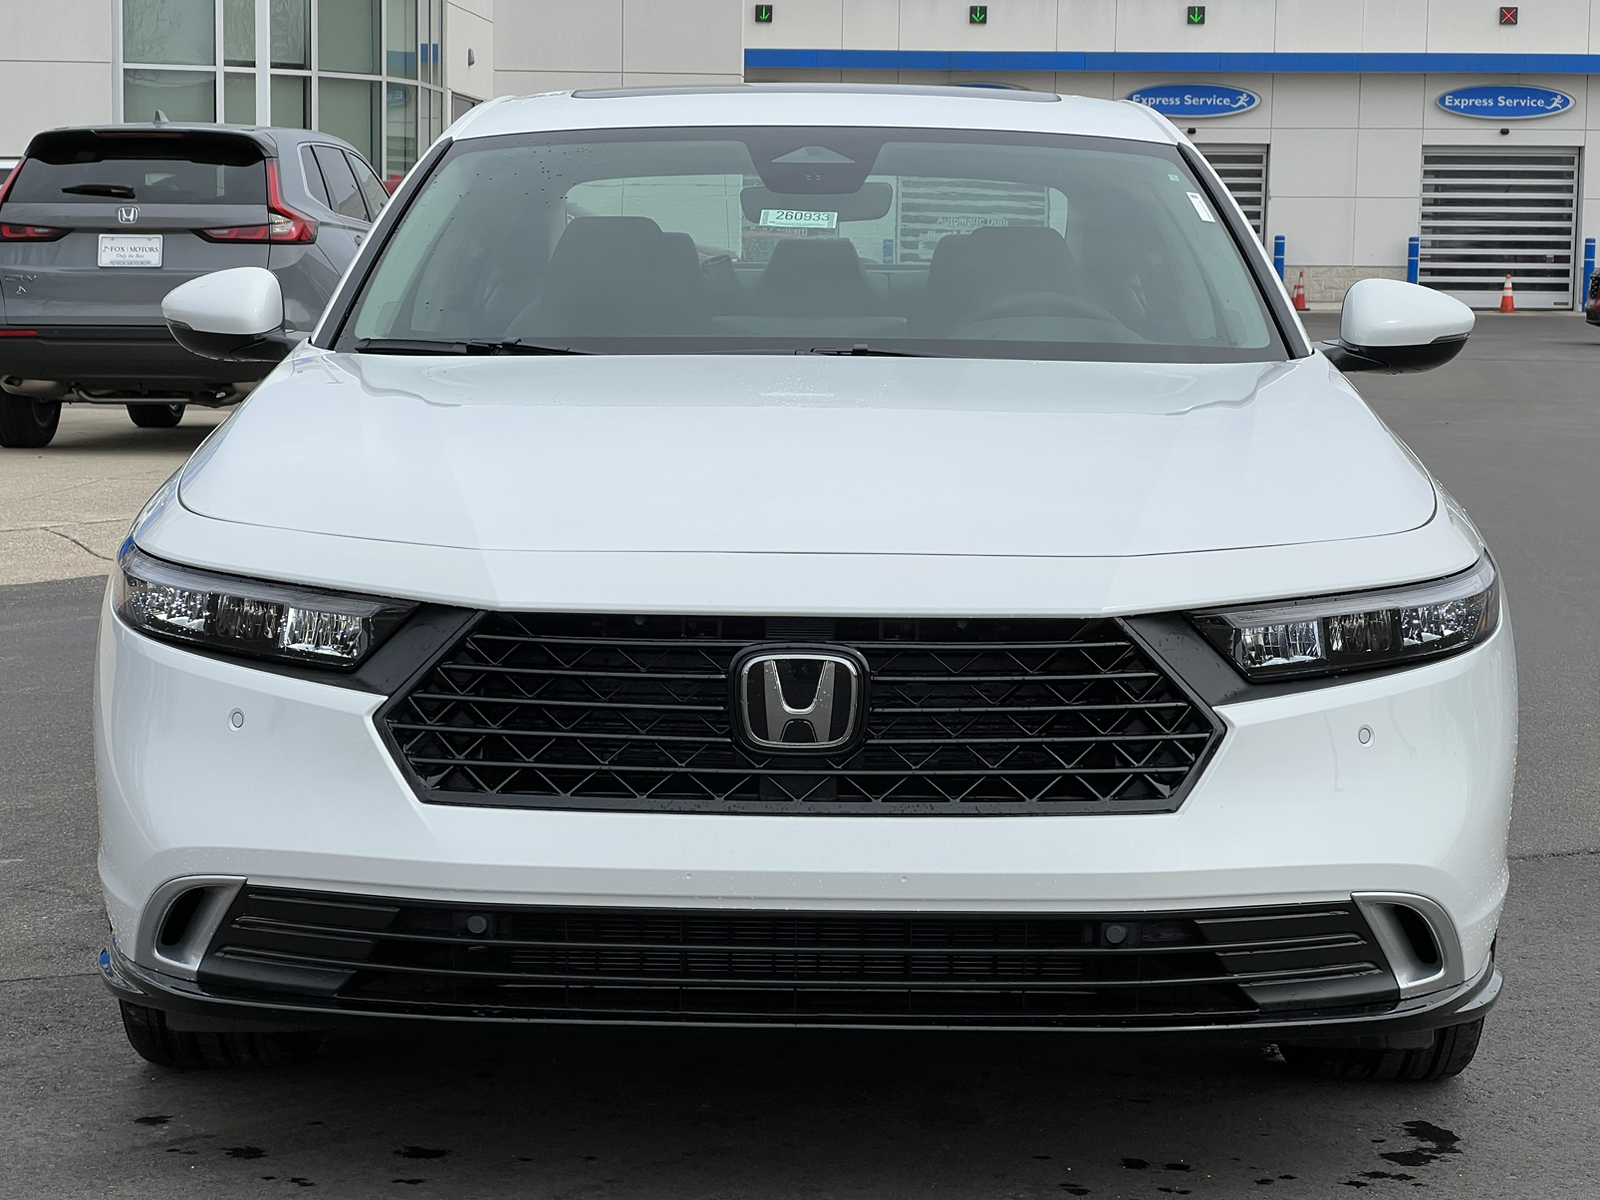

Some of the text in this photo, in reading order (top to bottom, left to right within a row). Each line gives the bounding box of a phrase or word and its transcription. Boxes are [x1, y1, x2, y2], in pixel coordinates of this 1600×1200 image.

[1132, 94, 1231, 107] Express Service
[1445, 95, 1545, 109] Express Service
[776, 210, 830, 221] 260933
